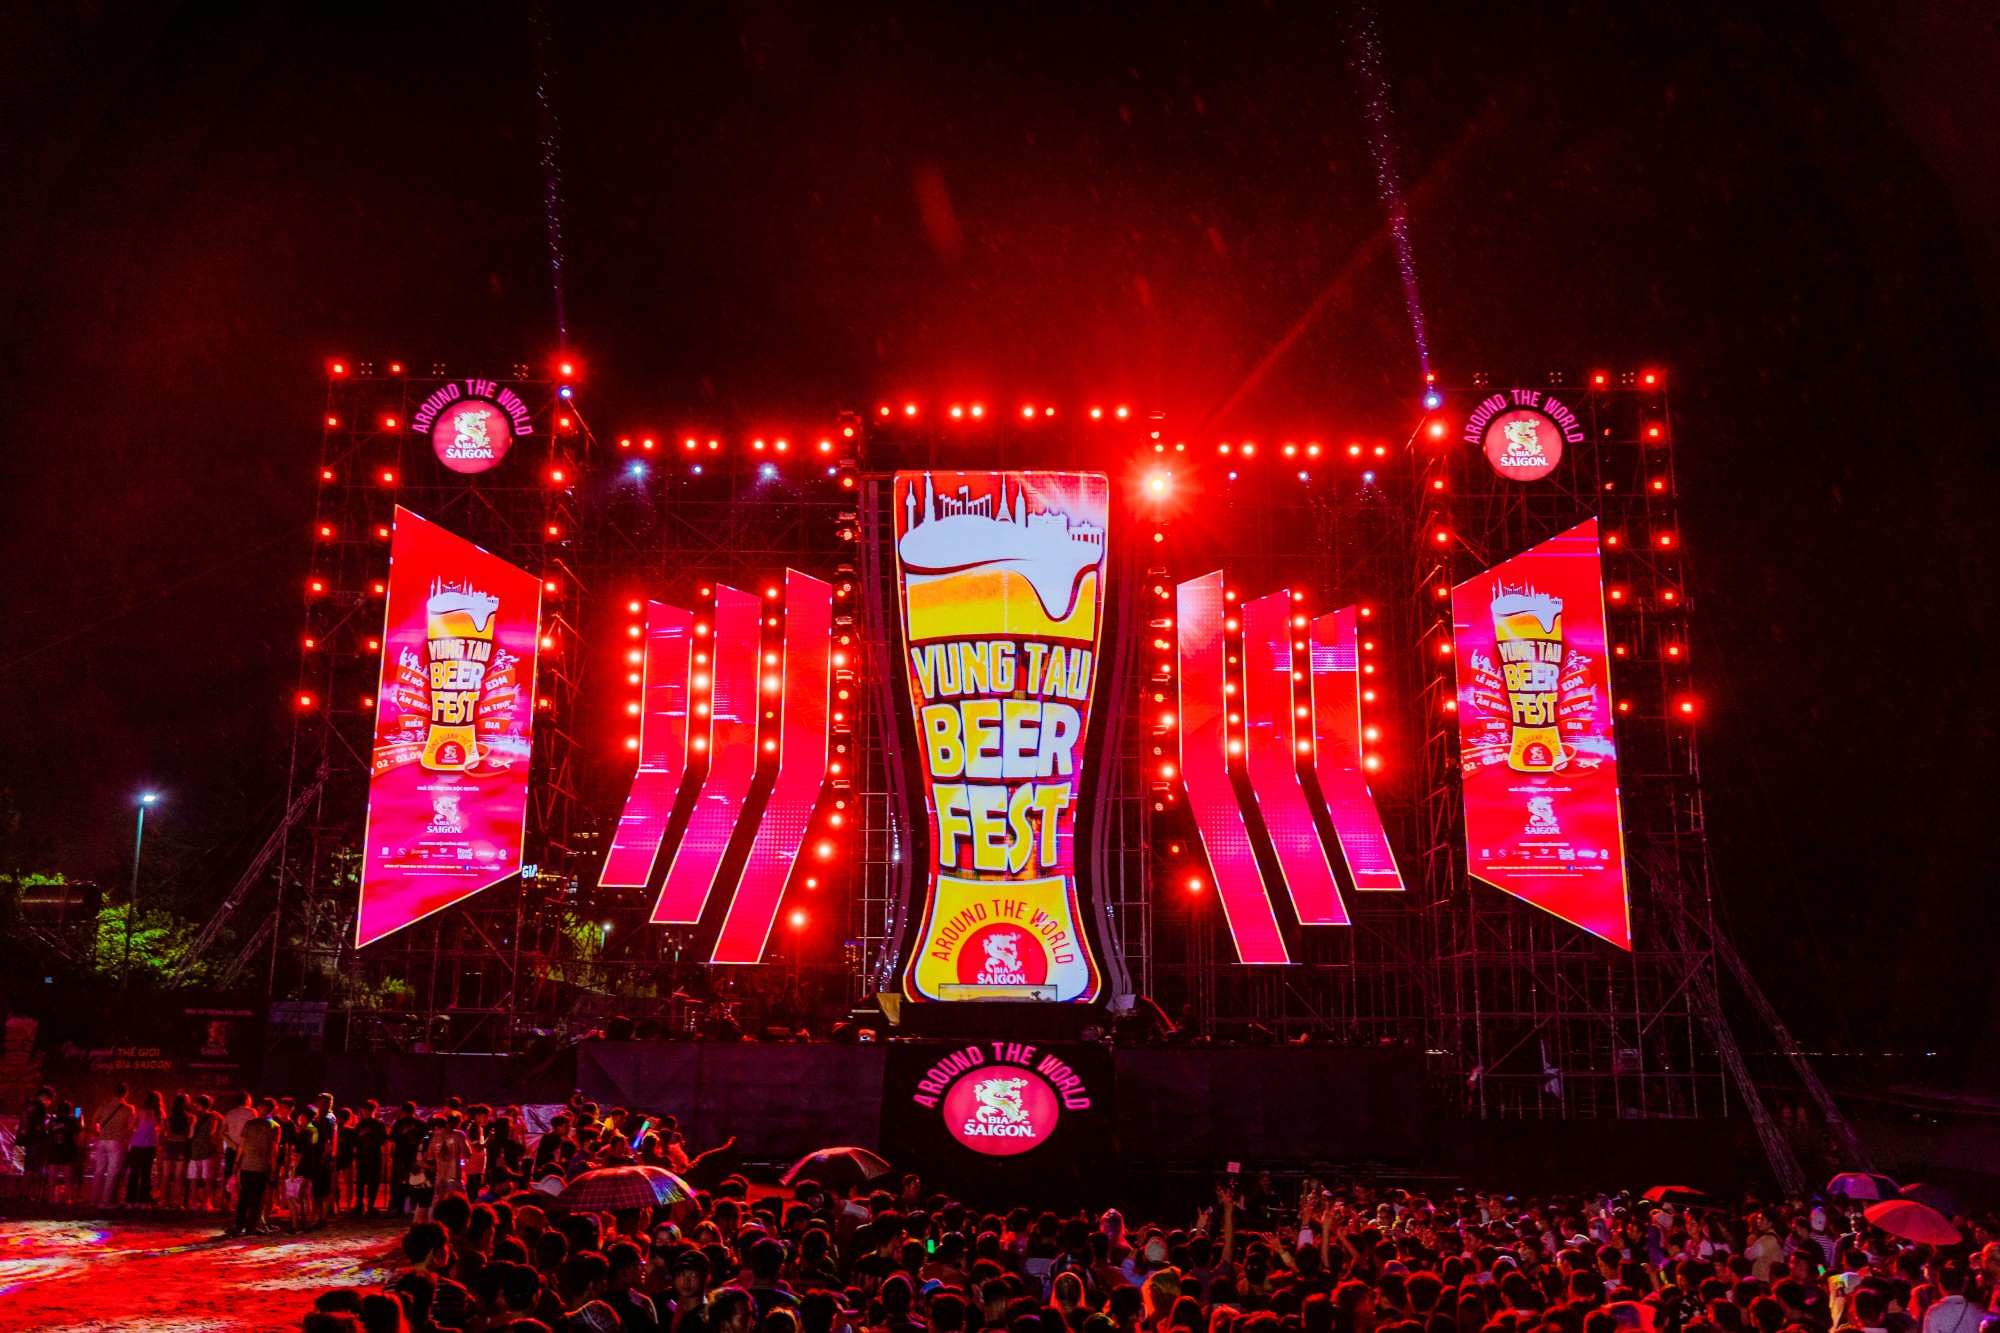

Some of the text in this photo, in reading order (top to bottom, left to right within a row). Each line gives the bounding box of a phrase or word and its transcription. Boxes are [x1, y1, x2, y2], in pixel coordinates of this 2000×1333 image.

[412, 379, 533, 436] AROUND THE WORLD
[1463, 389, 1584, 444] AROUND THE WORLD
[428, 639, 492, 662] VUNG TAU
[1497, 640, 1562, 662] VUNG TAU
[429, 660, 486, 690] BEER
[485, 675, 508, 690] EDM
[910, 641, 1092, 700] VUNG TAU
[1502, 662, 1560, 692] BEER
[431, 690, 480, 724] FEST
[1508, 692, 1558, 725] FEST
[485, 721, 500, 729] BIA
[921, 699, 1080, 778] BEER
[376, 759, 389, 768] 02
[932, 782, 1071, 873] FEST
[931, 899, 1074, 965] AROUND THE WORLD
[994, 966, 1009, 974] BIA
[913, 1042, 1091, 1111] AROUND THE WORLD
[988, 1117, 1010, 1125] BIA
